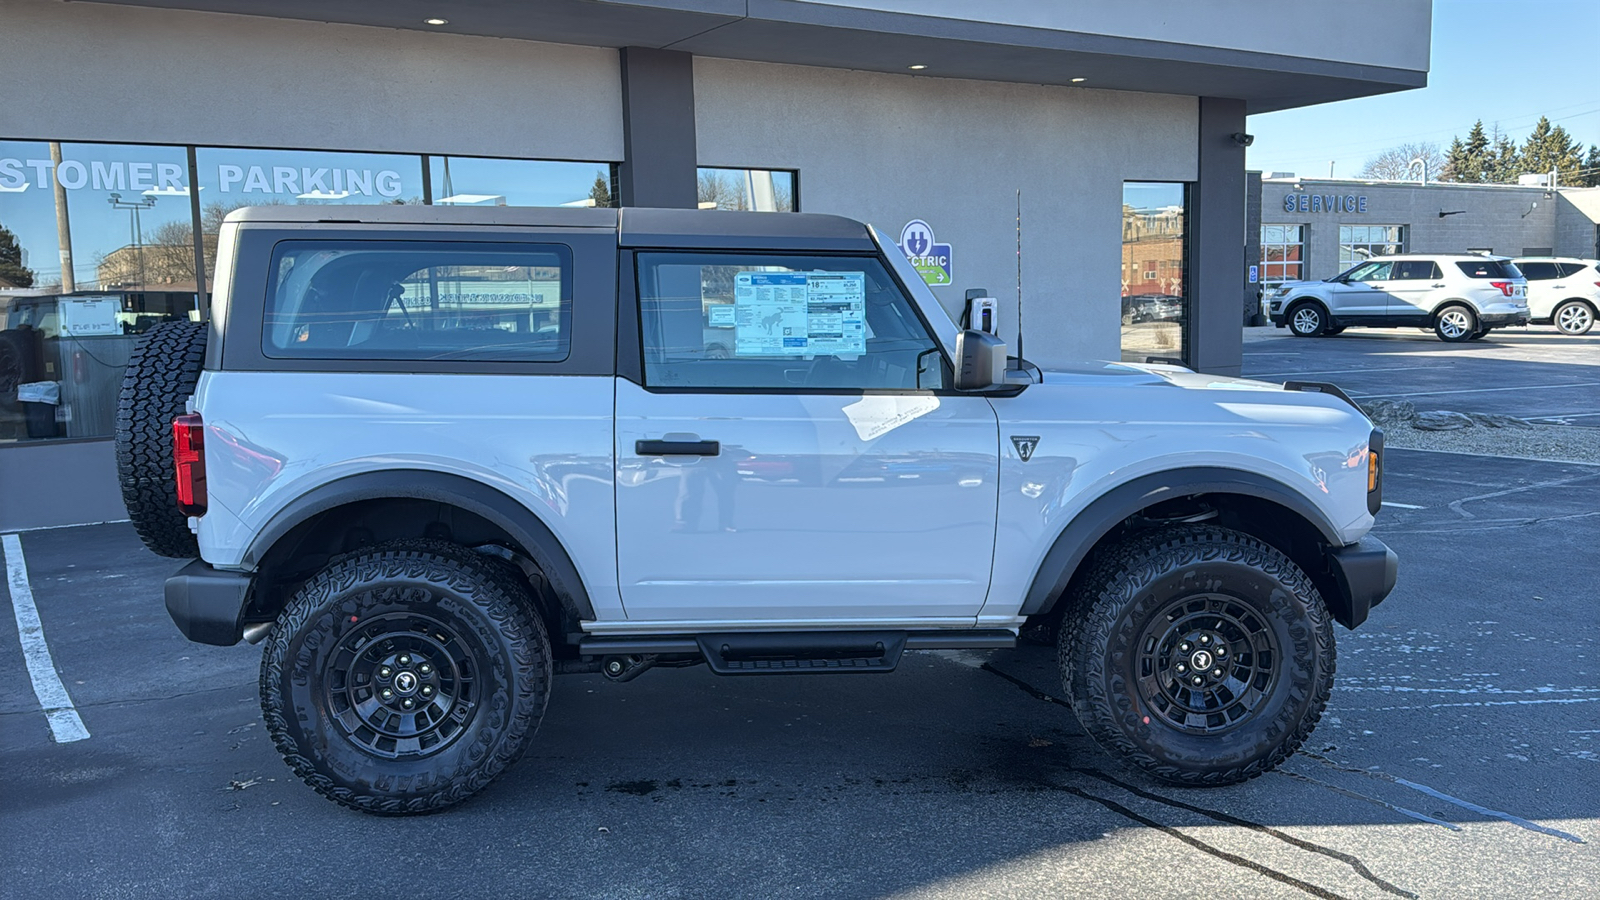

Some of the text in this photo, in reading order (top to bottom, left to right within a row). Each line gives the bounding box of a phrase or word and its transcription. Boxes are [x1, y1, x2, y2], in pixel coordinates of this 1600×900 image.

[0, 158, 402, 197] STOMER PARKING
[1284, 194, 1367, 213] SERVICE
